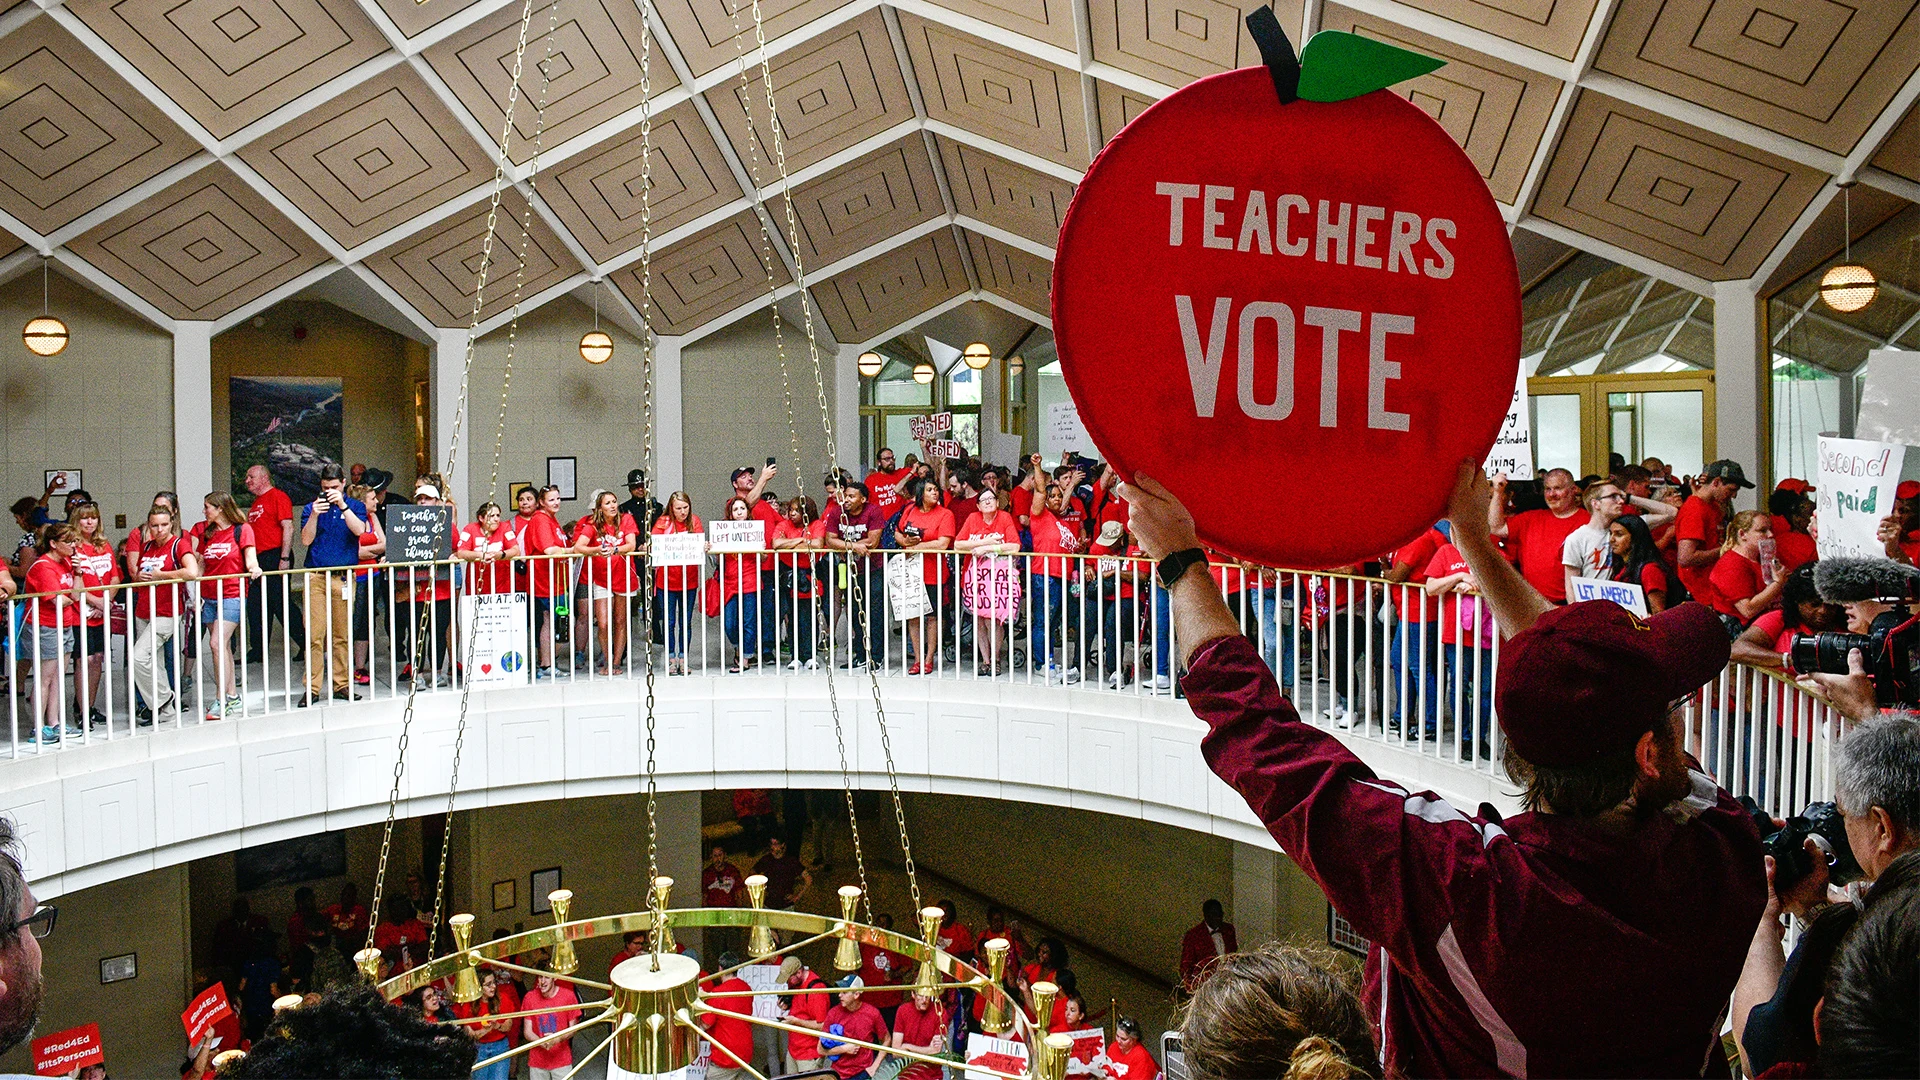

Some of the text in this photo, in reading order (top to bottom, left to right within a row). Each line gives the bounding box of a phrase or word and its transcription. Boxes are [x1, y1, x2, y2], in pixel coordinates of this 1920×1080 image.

[1155, 181, 1457, 280] TEACHERS
[1174, 294, 1416, 432] VOTE
[1495, 430, 1528, 445] erfunded
[1490, 456, 1516, 473] iving
[1820, 441, 1891, 477] Second
[1836, 485, 1878, 519] paid
[401, 509, 439, 523] together
[393, 523, 445, 533] we can do
[716, 521, 753, 530] NO CHILD
[407, 535, 431, 546] great
[712, 533, 729, 543] LEFT
[404, 546, 435, 559] things
[475, 593, 526, 605] DUCATON
[1577, 583, 1595, 600] LET
[43, 1034, 90, 1055] #Red4Ed
[990, 1039, 1020, 1056] LISTEN
[37, 1045, 100, 1070] #ItsPersonal
